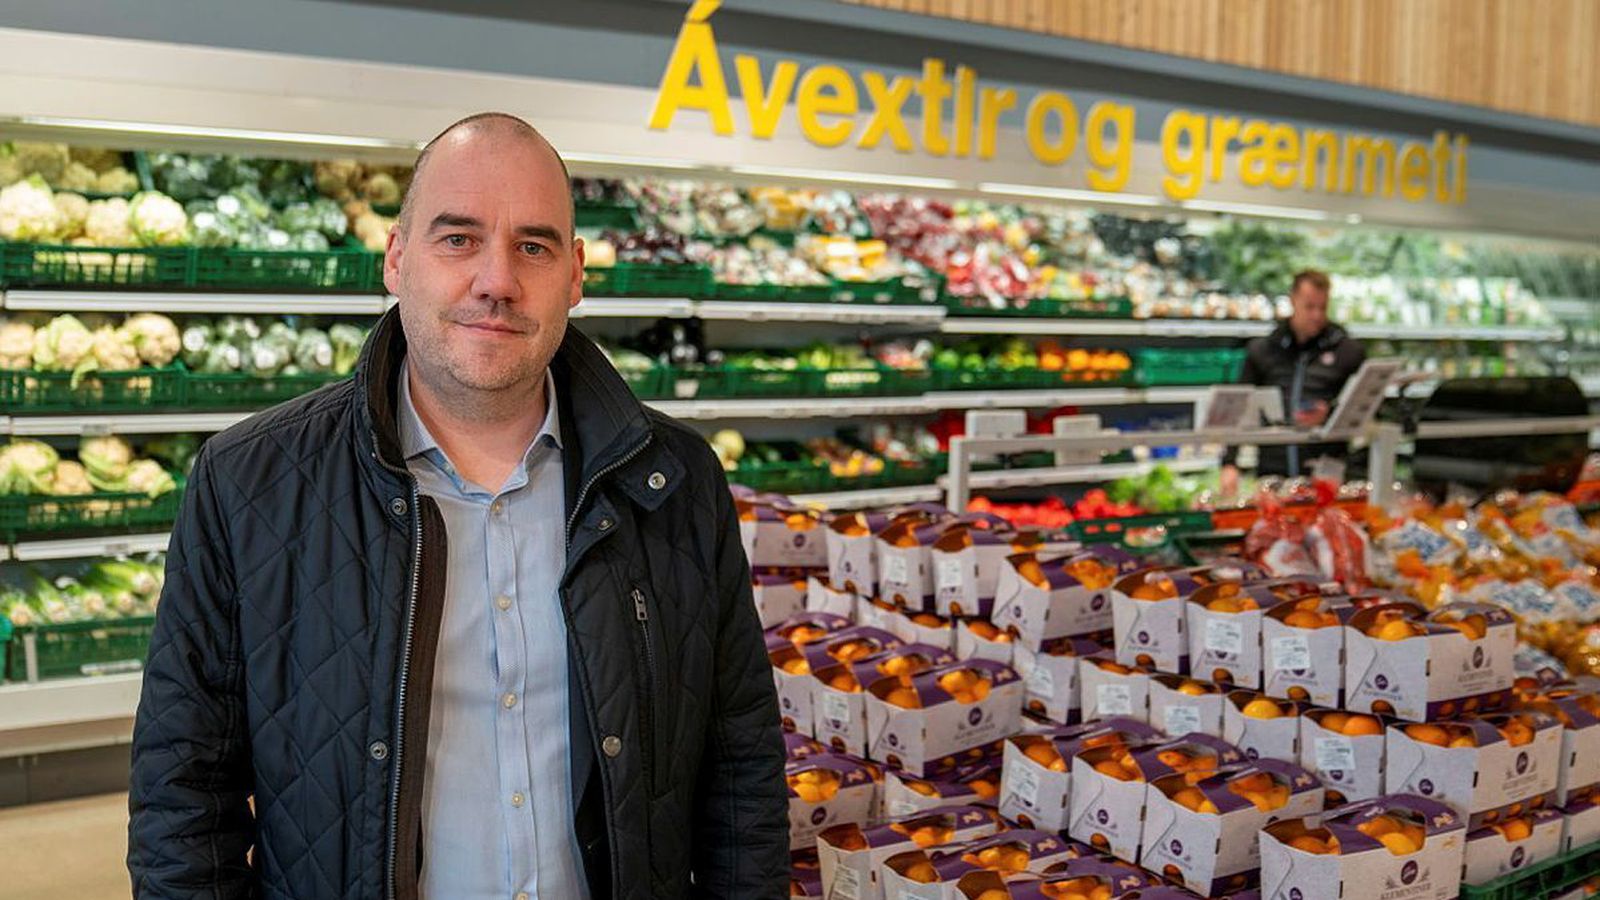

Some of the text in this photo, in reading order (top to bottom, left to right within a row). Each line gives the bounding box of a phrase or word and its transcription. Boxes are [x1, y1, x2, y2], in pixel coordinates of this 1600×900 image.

[649, 0, 1468, 205] Ávextir og grænmeti
